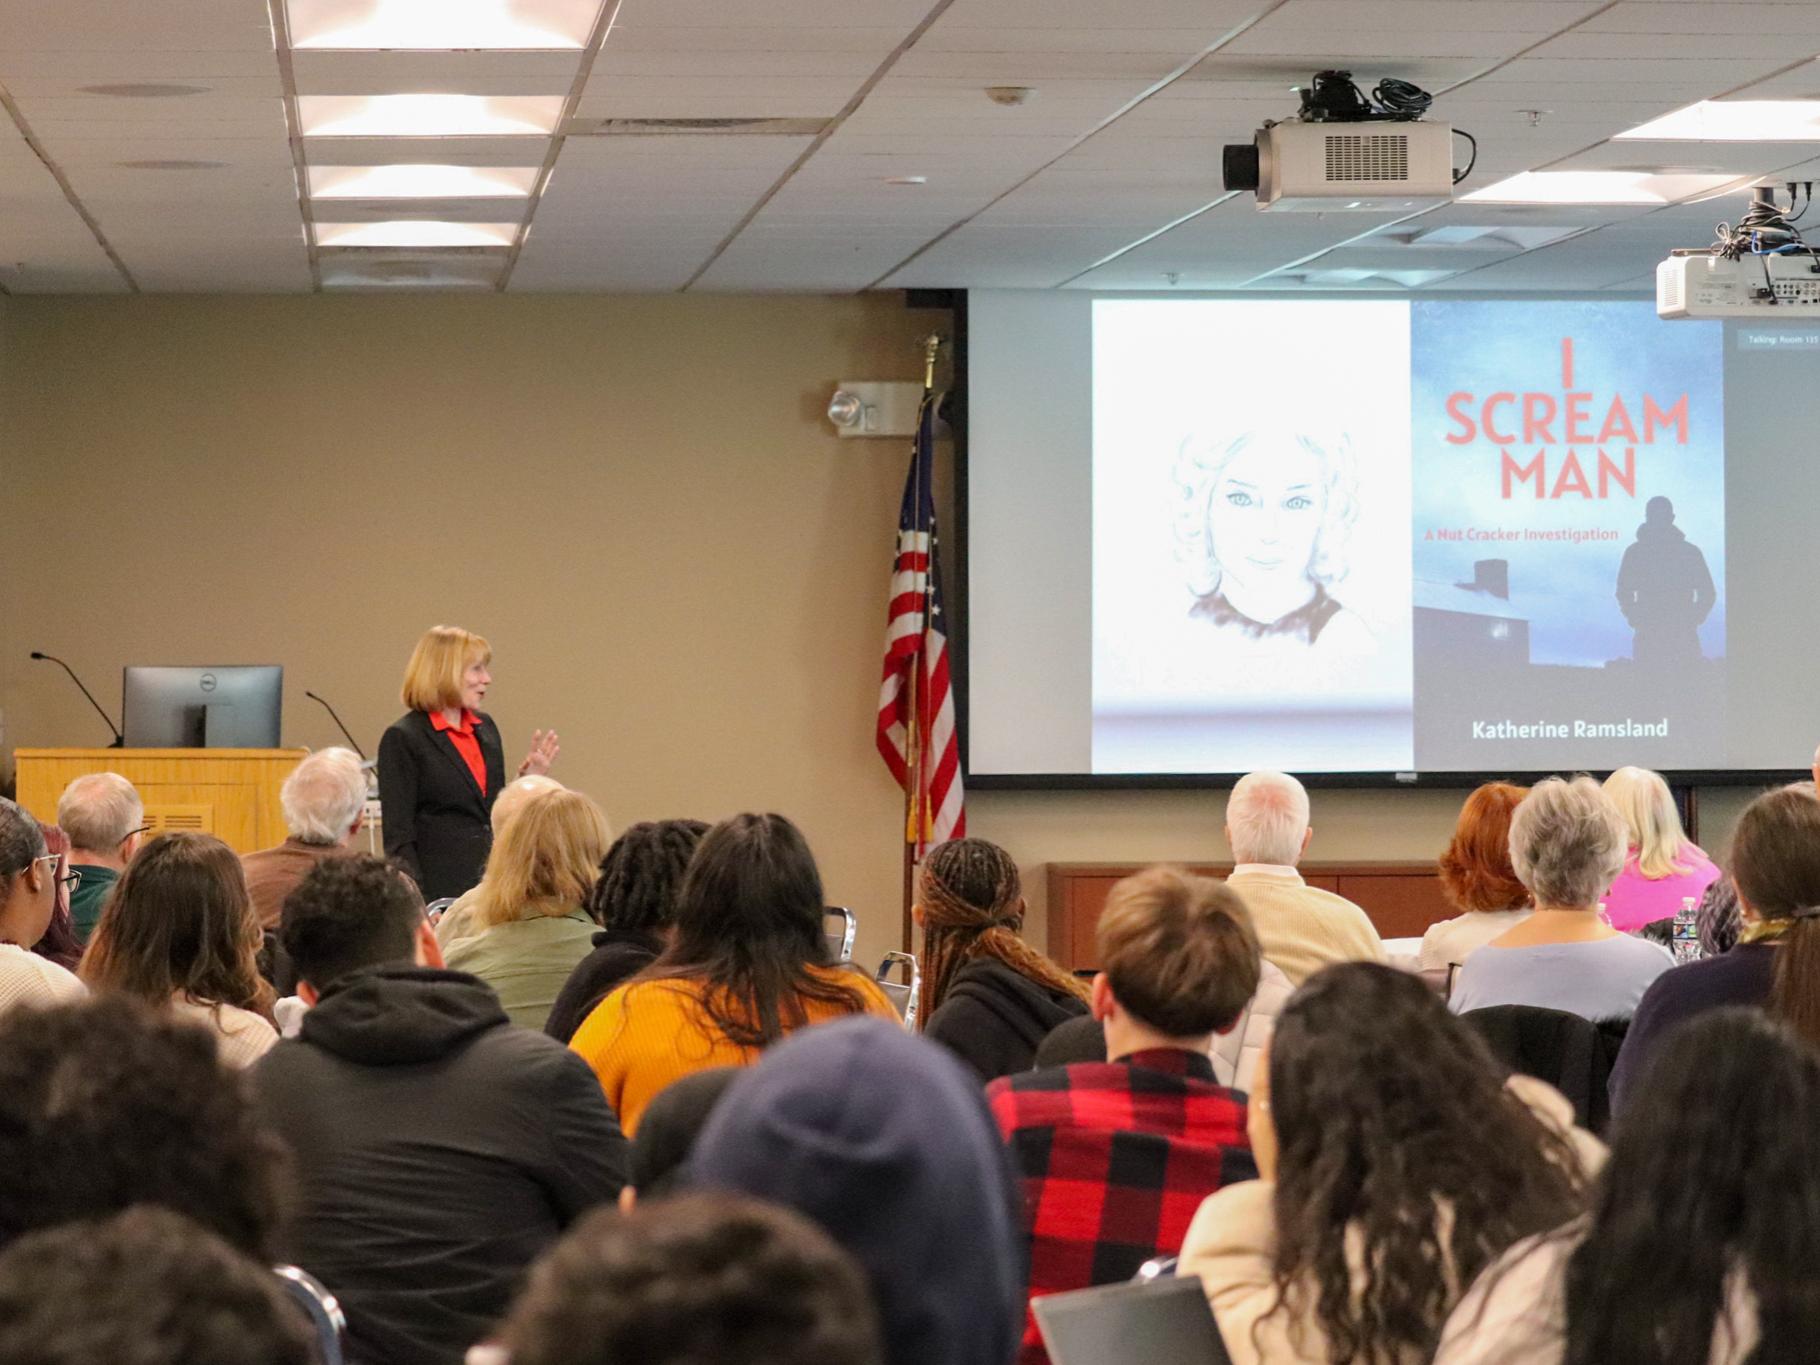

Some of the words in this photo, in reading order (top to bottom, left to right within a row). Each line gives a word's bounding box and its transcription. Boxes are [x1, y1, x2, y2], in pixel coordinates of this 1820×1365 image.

[1779, 336, 1803, 345] Room
[1561, 337, 1574, 390] I
[1444, 391, 1690, 446] SCREAM
[1501, 447, 1637, 499] MAN
[1424, 528, 1434, 541] A
[1437, 528, 1464, 541] Nut
[1466, 528, 1521, 541] Cracker
[1524, 528, 1619, 544] Investigation
[1472, 720, 1569, 739] Katherine
[1574, 718, 1668, 738] Ramsland
